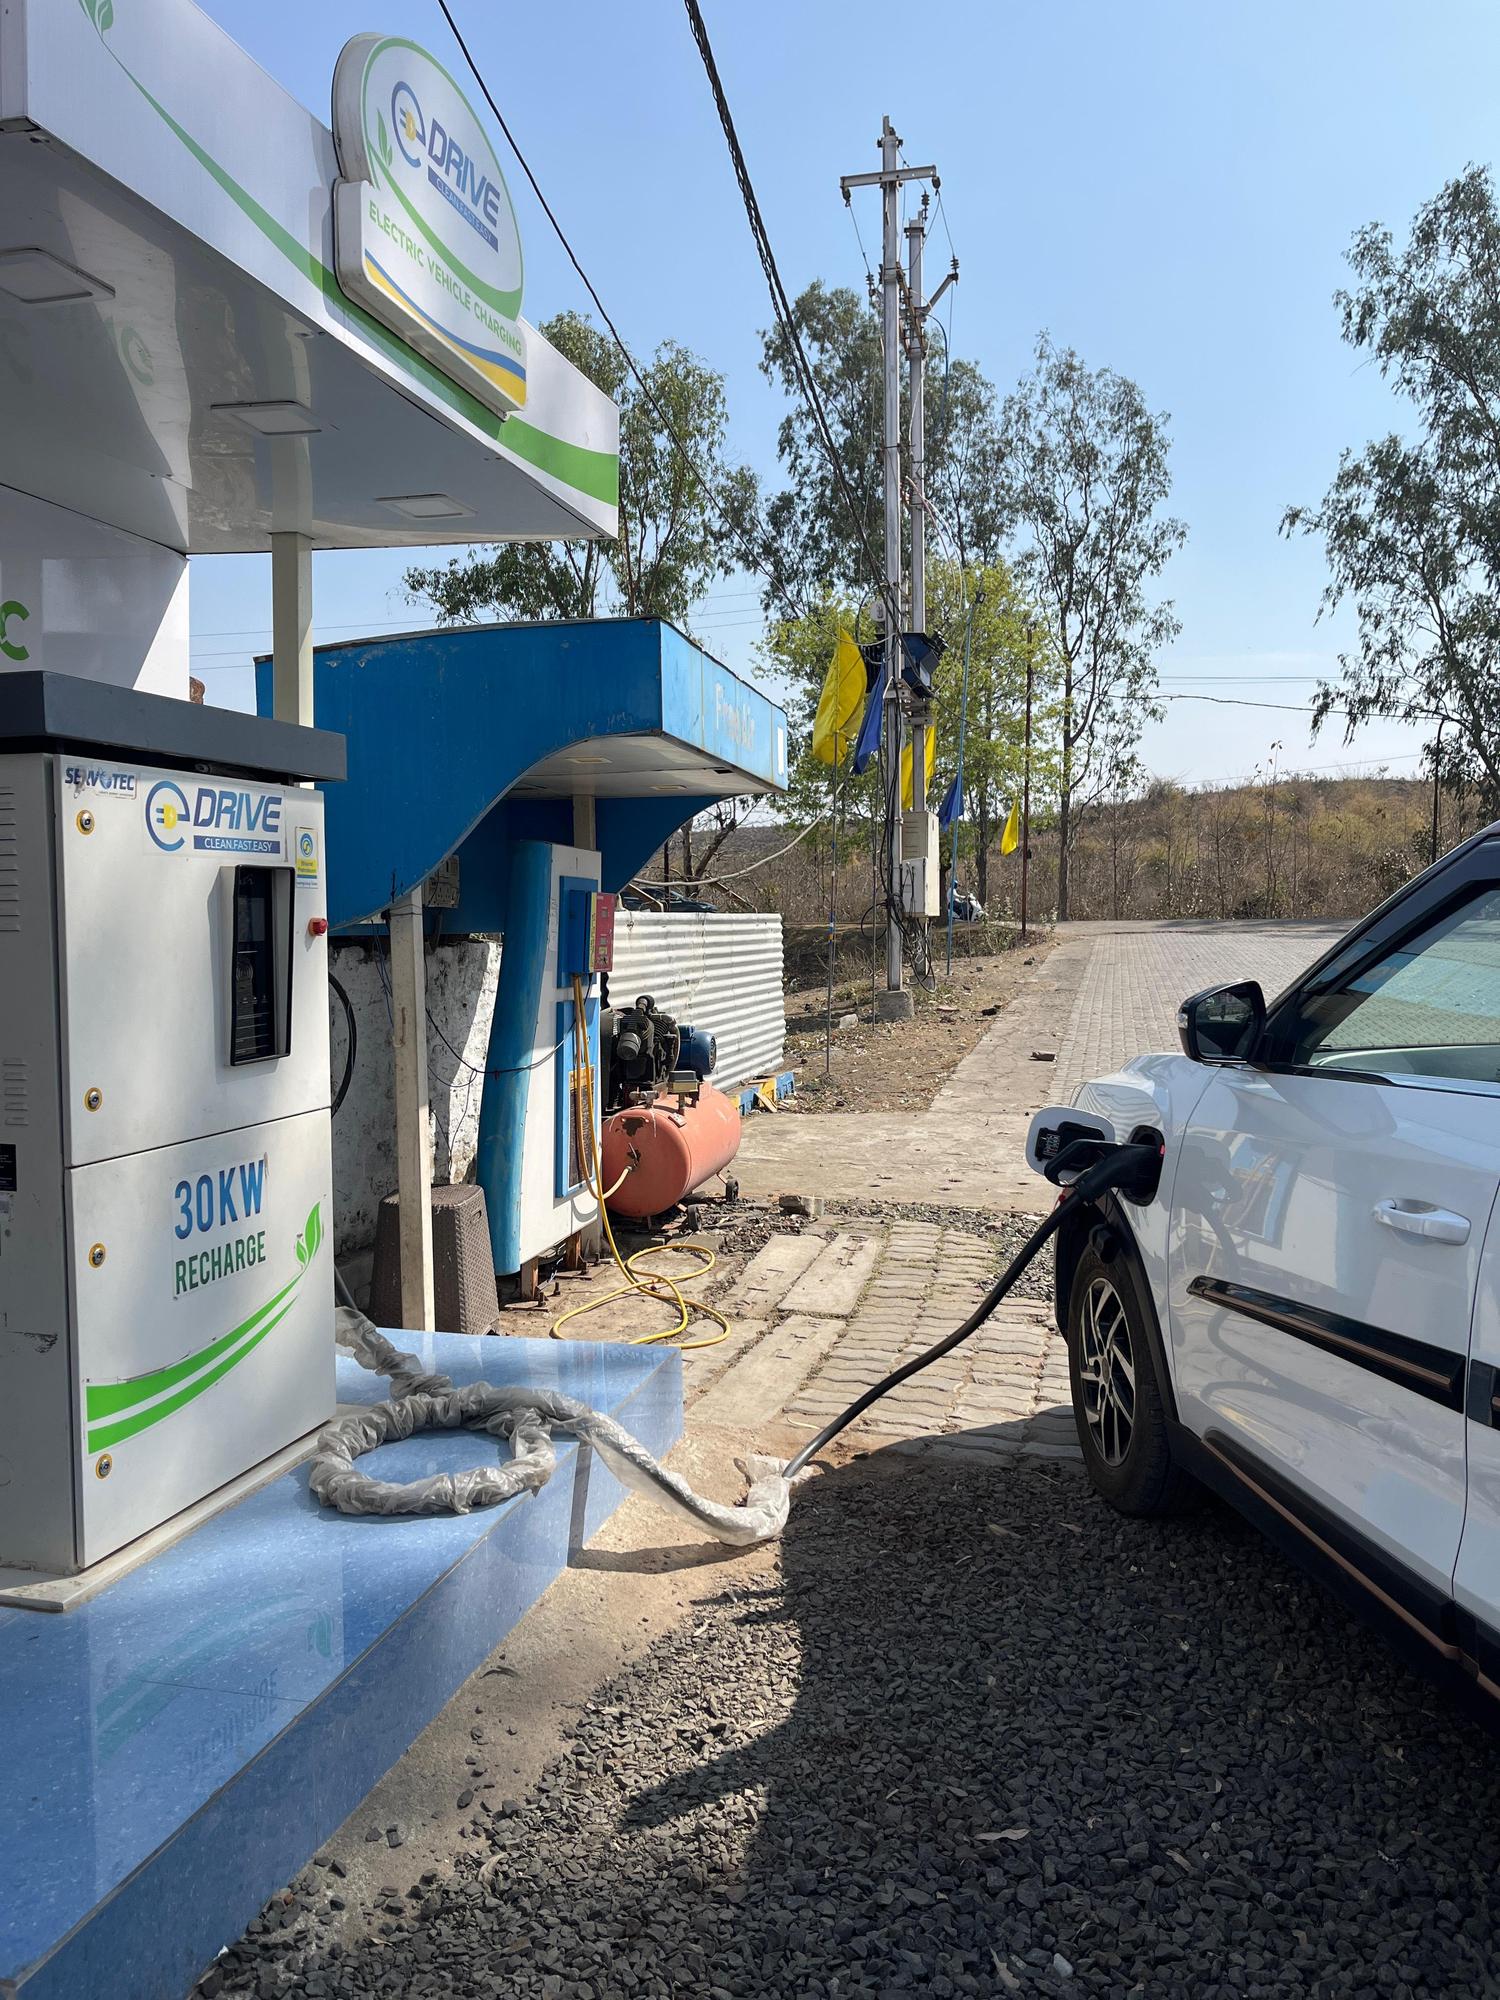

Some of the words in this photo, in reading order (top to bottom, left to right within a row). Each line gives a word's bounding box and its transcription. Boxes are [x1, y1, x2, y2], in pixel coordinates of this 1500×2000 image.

[370, 200, 425, 267] ELECTRIC
[428, 256, 471, 312] VEHICLE
[473, 302, 522, 357] CHARGING
[174, 1159, 264, 1240] 30KW
[175, 1230, 266, 1295] RECHARGE
